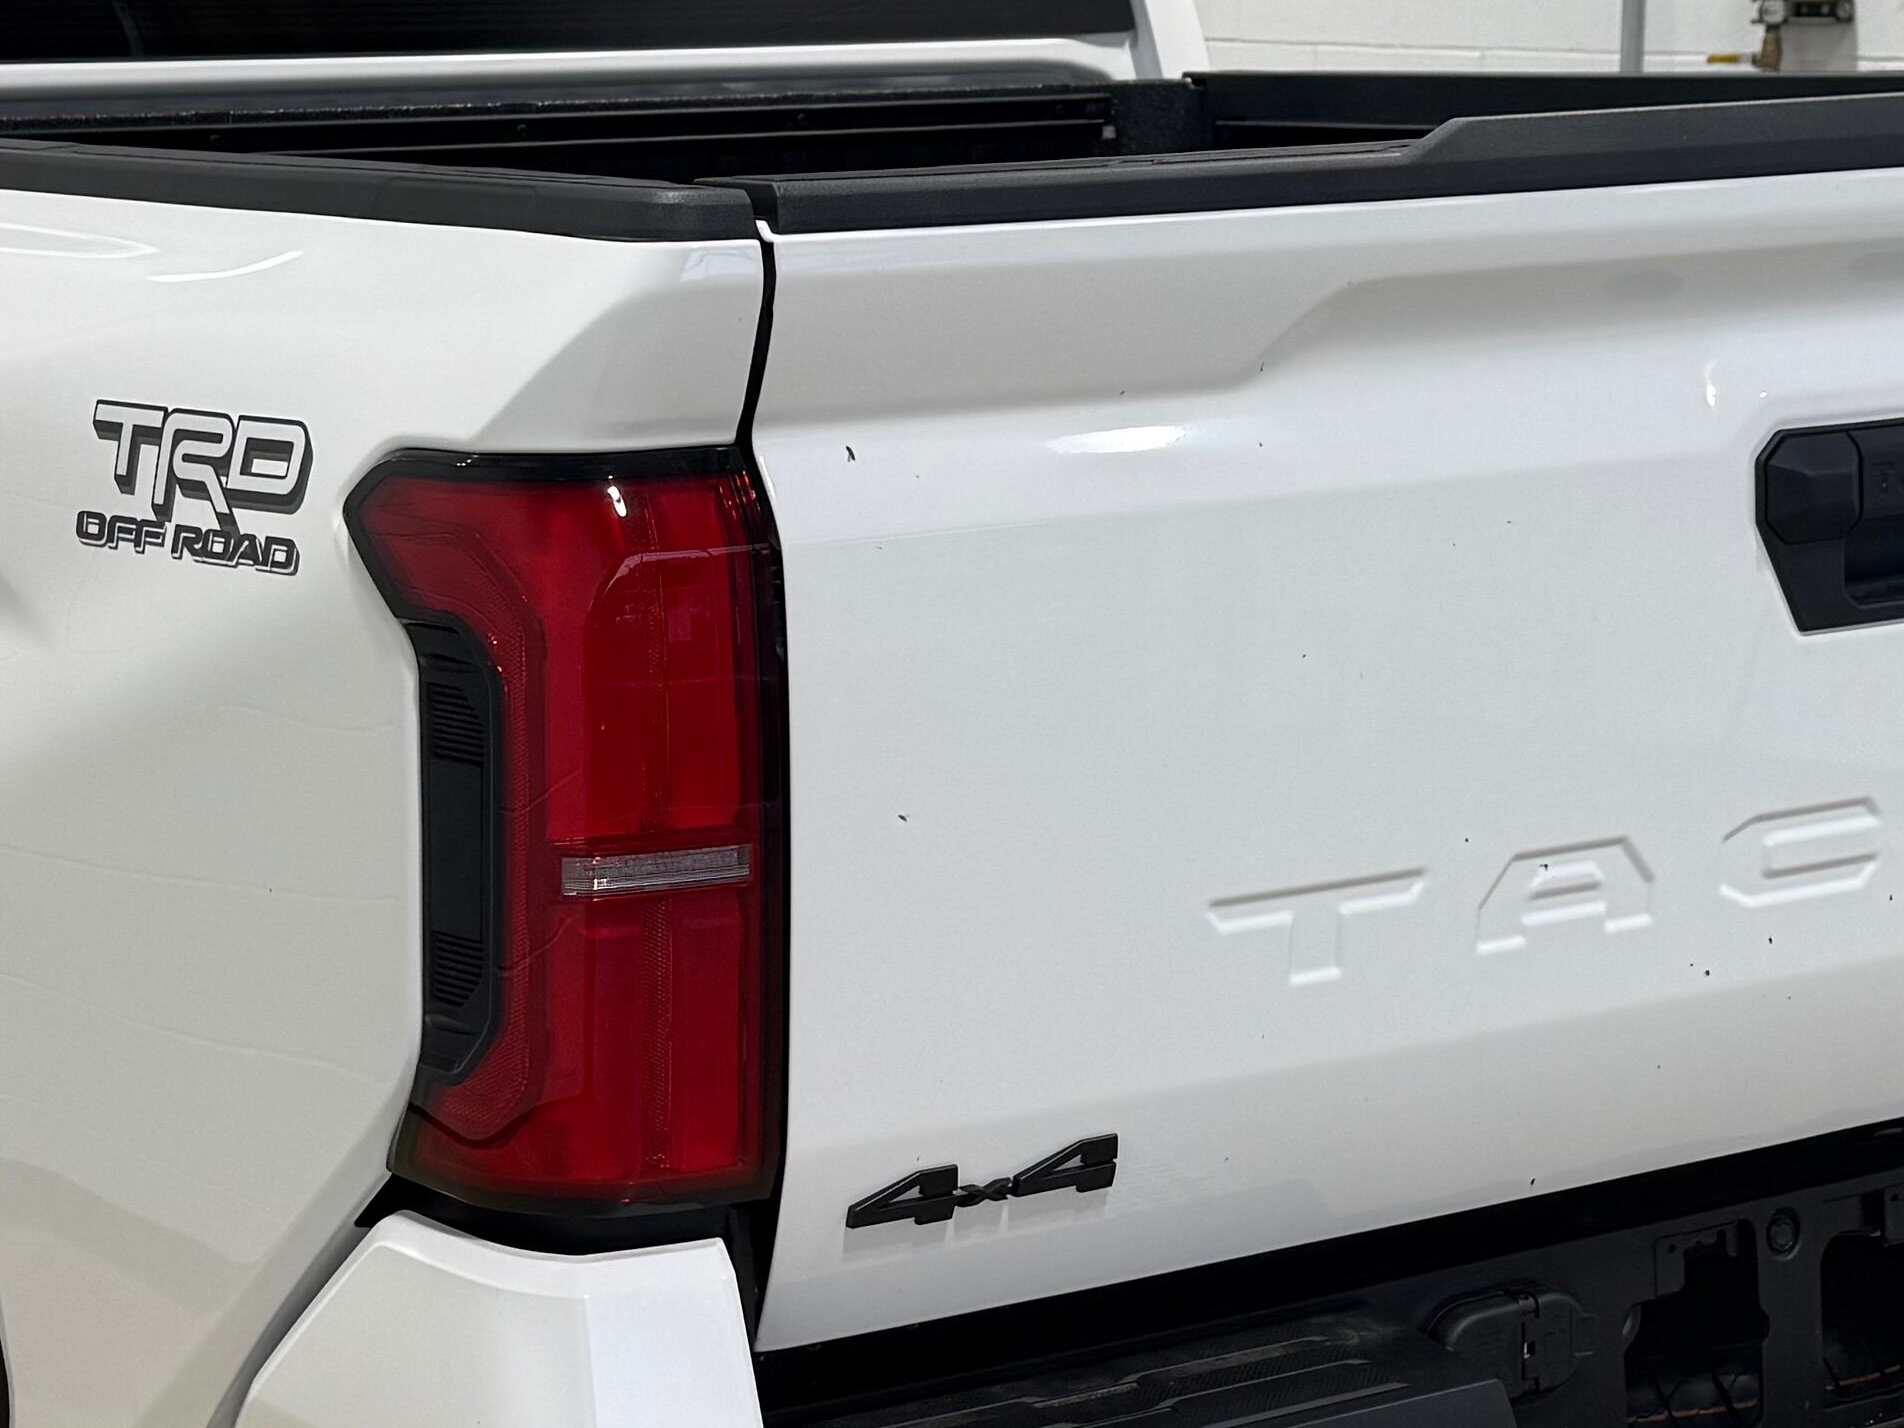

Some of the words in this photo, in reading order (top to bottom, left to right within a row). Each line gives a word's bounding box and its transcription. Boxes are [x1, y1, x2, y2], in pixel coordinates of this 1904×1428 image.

[92, 399, 314, 535] TRD
[75, 510, 167, 555] OFF
[171, 523, 301, 576] ROAD
